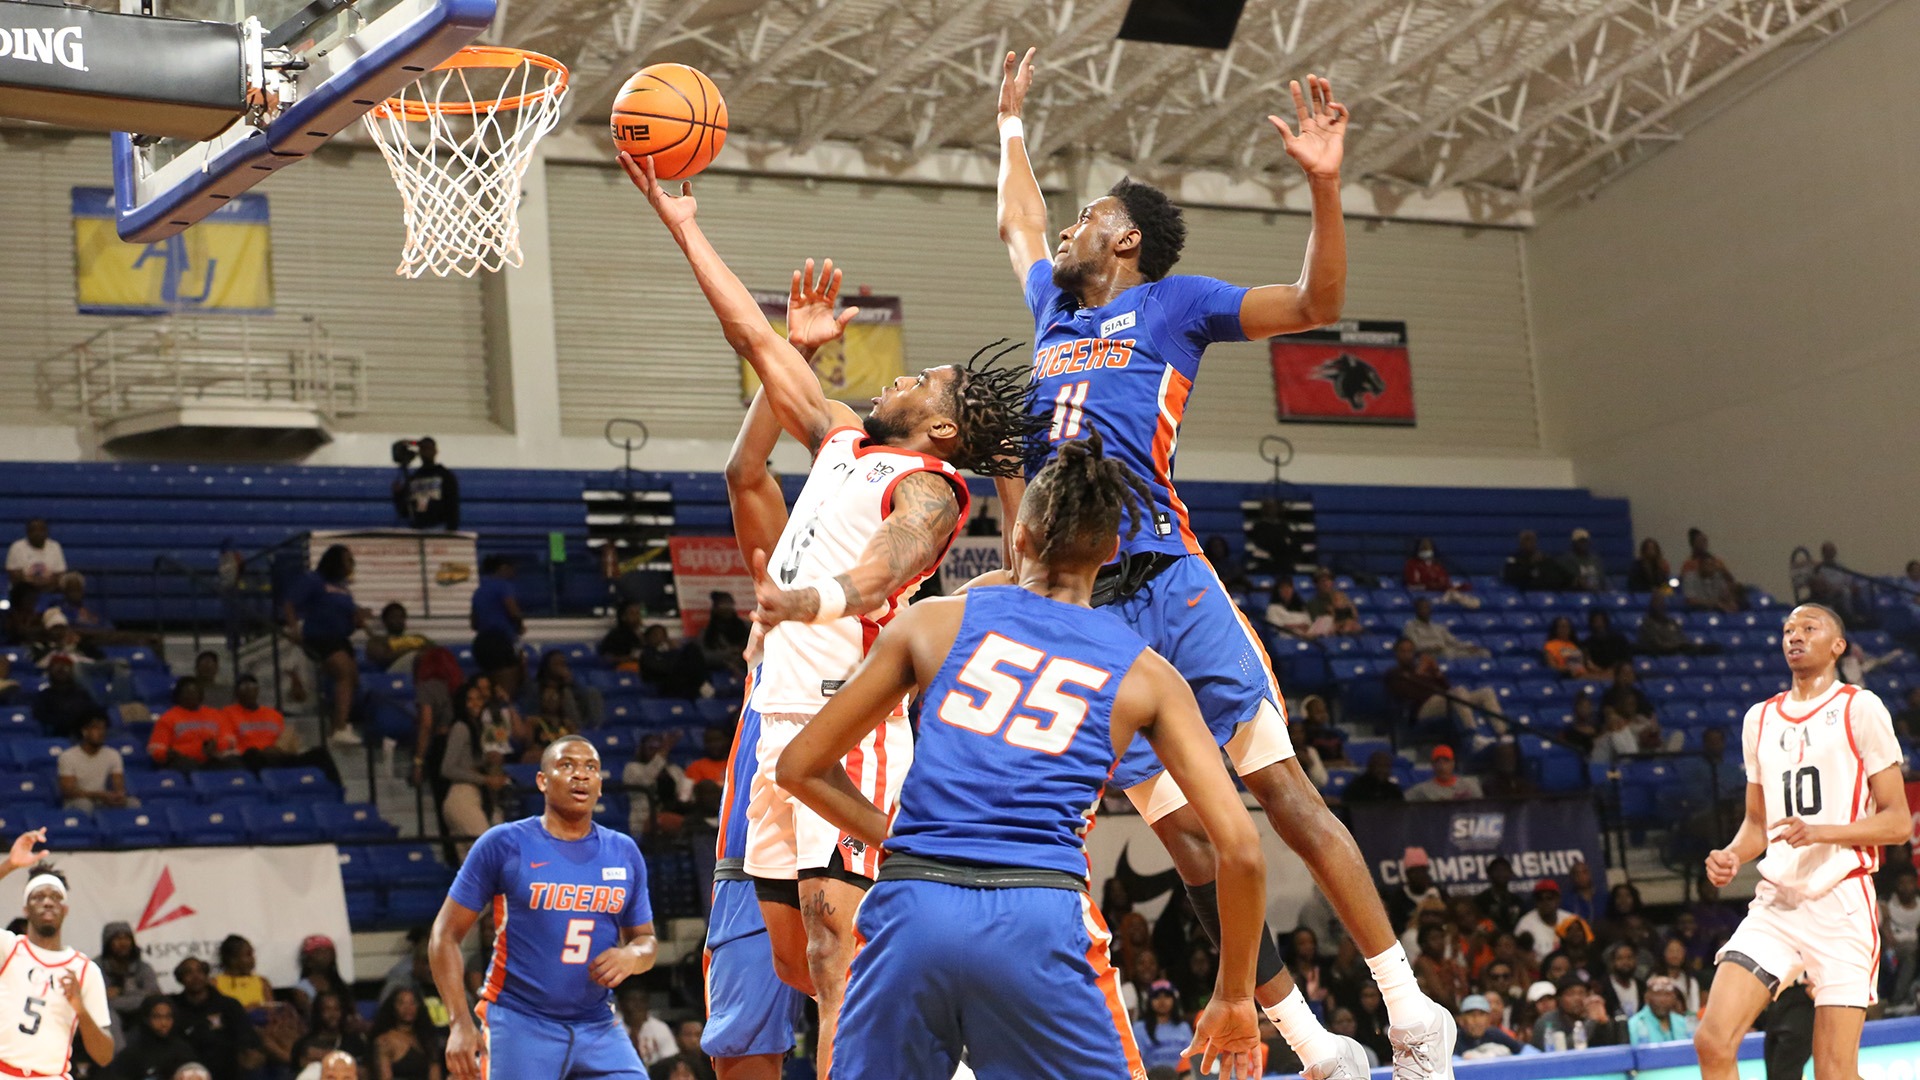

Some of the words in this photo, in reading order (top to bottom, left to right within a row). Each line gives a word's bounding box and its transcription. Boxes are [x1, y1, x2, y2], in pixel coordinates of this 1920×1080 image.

[1104, 316, 1131, 334] SIAC
[1029, 337, 1136, 382] TIGERS
[1048, 380, 1090, 442] 11
[937, 630, 1112, 757] 55
[1782, 765, 1822, 817] 10
[1453, 818, 1502, 839] SIAC
[1379, 849, 1585, 886] CAMPINSHIP
[529, 882, 626, 914] TIGERS
[561, 918, 595, 965] 5
[18, 996, 46, 1036] 5
